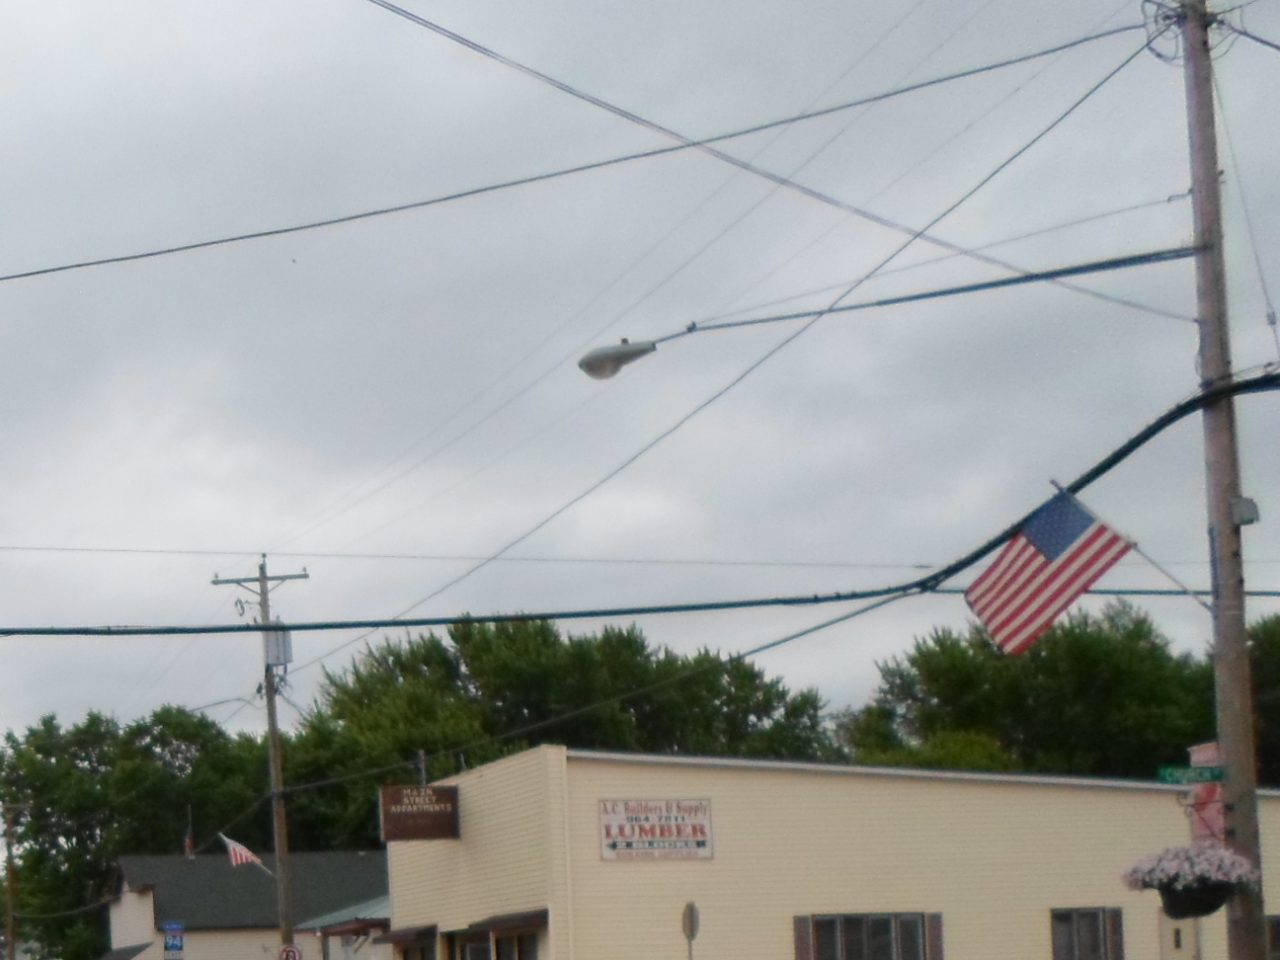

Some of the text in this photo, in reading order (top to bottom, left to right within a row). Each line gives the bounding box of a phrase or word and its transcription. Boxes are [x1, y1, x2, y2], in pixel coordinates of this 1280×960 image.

[402, 796, 437, 804] STREET
[604, 823, 707, 839] LUMBER
[166, 935, 181, 947] 94
